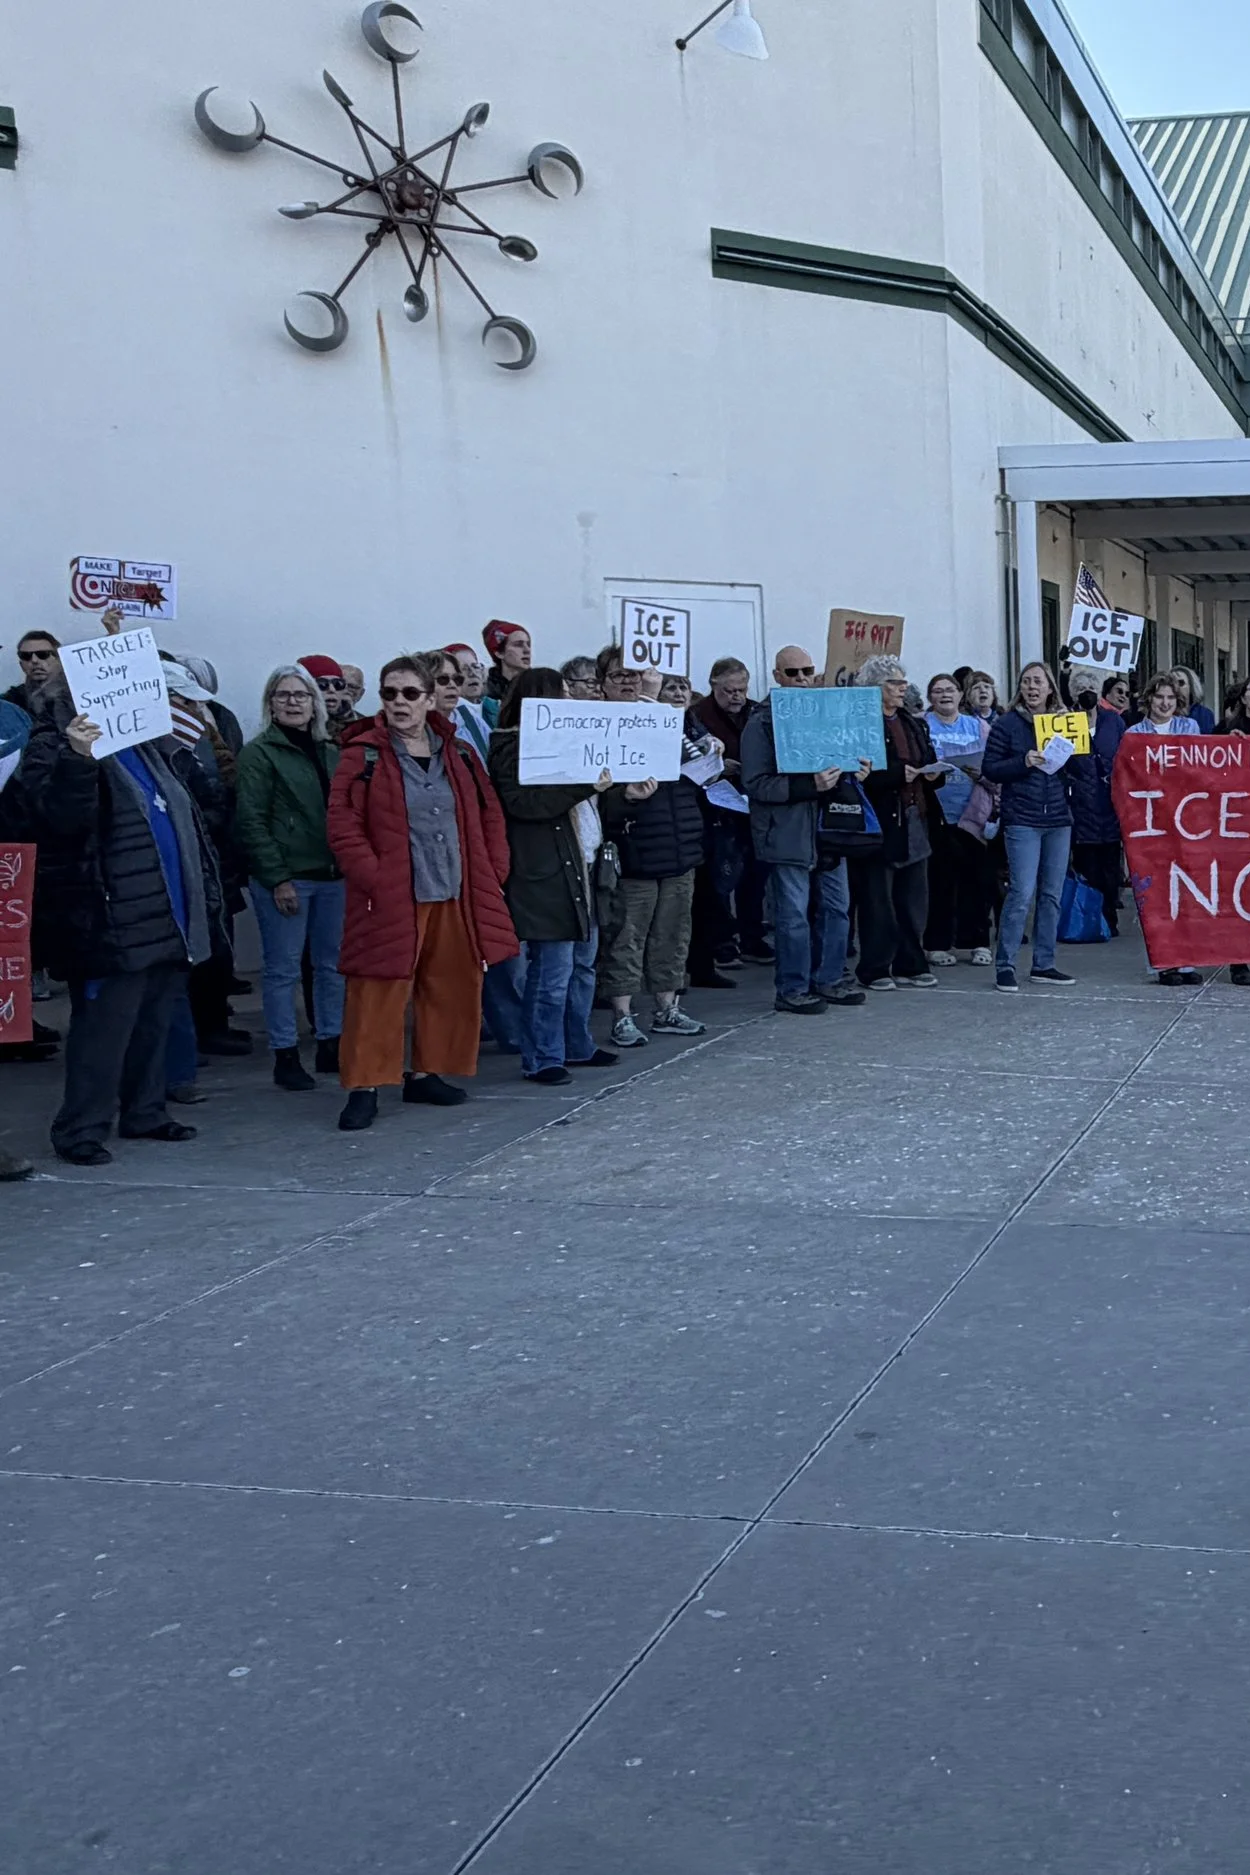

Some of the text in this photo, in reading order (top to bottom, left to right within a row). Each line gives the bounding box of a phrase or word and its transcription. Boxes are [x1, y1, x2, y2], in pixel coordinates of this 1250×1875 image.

[131, 567, 162, 579] Target
[633, 607, 676, 637] ICE
[845, 621, 894, 646] ICE OUT
[1082, 612, 1129, 637] ICE
[632, 639, 681, 668] OUT
[1069, 632, 1141, 668] OUT!
[97, 665, 128, 680] Stop
[80, 679, 161, 709] Supporting
[106, 708, 148, 738] ICE
[536, 704, 612, 737] Democracy
[618, 714, 657, 737] protects
[1041, 715, 1078, 733] ICE
[584, 743, 647, 767] Not Ice
[1042, 734, 1085, 751] OT!
